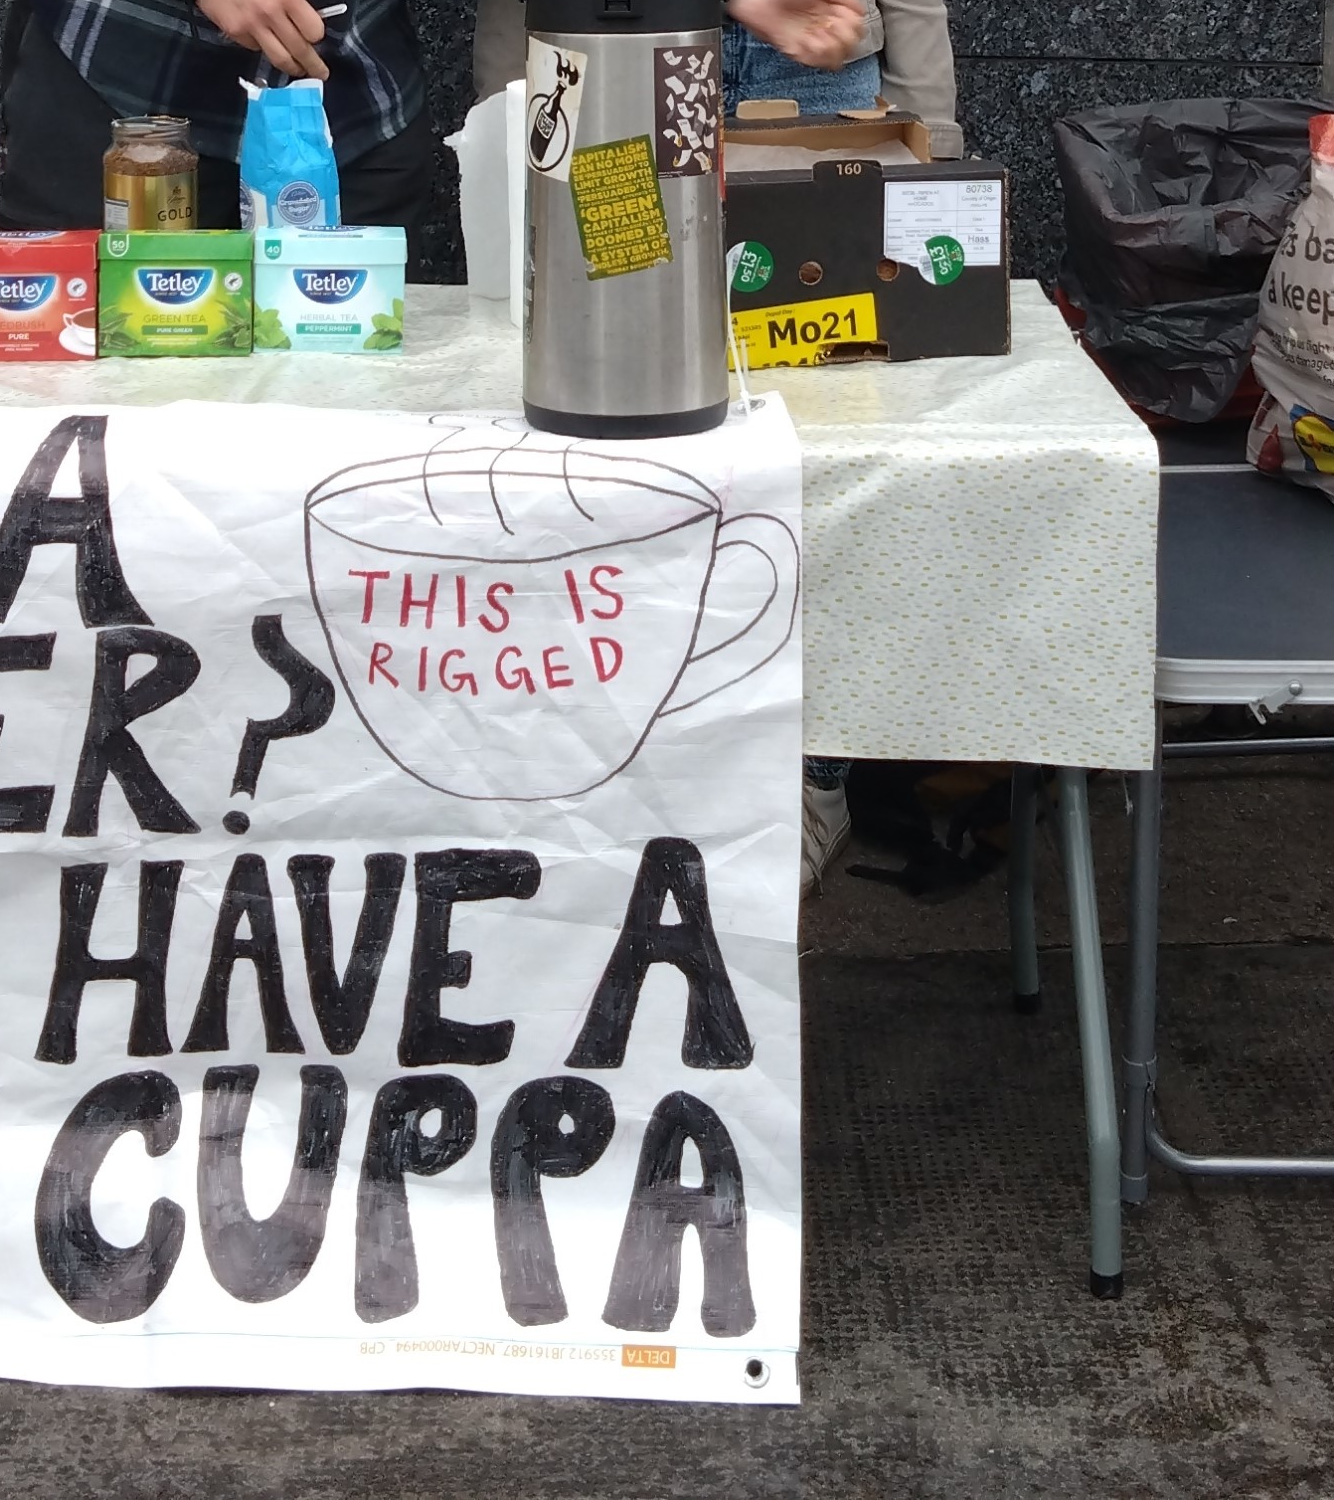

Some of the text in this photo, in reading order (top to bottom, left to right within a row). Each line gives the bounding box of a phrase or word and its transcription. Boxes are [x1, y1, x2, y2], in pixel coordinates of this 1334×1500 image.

[571, 141, 647, 165] CAPITALISM
[572, 152, 648, 175] CAN NO MORE
[574, 180, 601, 191] LIMIT
[603, 167, 653, 185] GROWTH
[836, 162, 862, 176] 160
[157, 206, 193, 222] GOLD
[583, 208, 661, 233] CAPITALISM
[111, 240, 125, 249] 50
[585, 228, 644, 249] DOOMED
[647, 222, 664, 236] BY
[967, 235, 990, 243] Hass
[266, 246, 280, 254] 40
[590, 254, 599, 263] A
[600, 243, 649, 260] SYSTEM
[594, 258, 628, 270] NDLESS
[147, 272, 205, 297] Tetley
[301, 272, 360, 297] Tetley
[143, 313, 207, 323] GREEN TEA
[300, 313, 359, 321] HERBAL TEA
[767, 307, 858, 349] Mo21
[1306, 340, 1330, 355] fight
[348, 564, 624, 634] THIS IS
[368, 636, 623, 696] RIGGED
[33, 835, 757, 1072] HAVE A
[34, 1062, 758, 1338] CUPPA
[626, 1348, 671, 1365] DELTA
